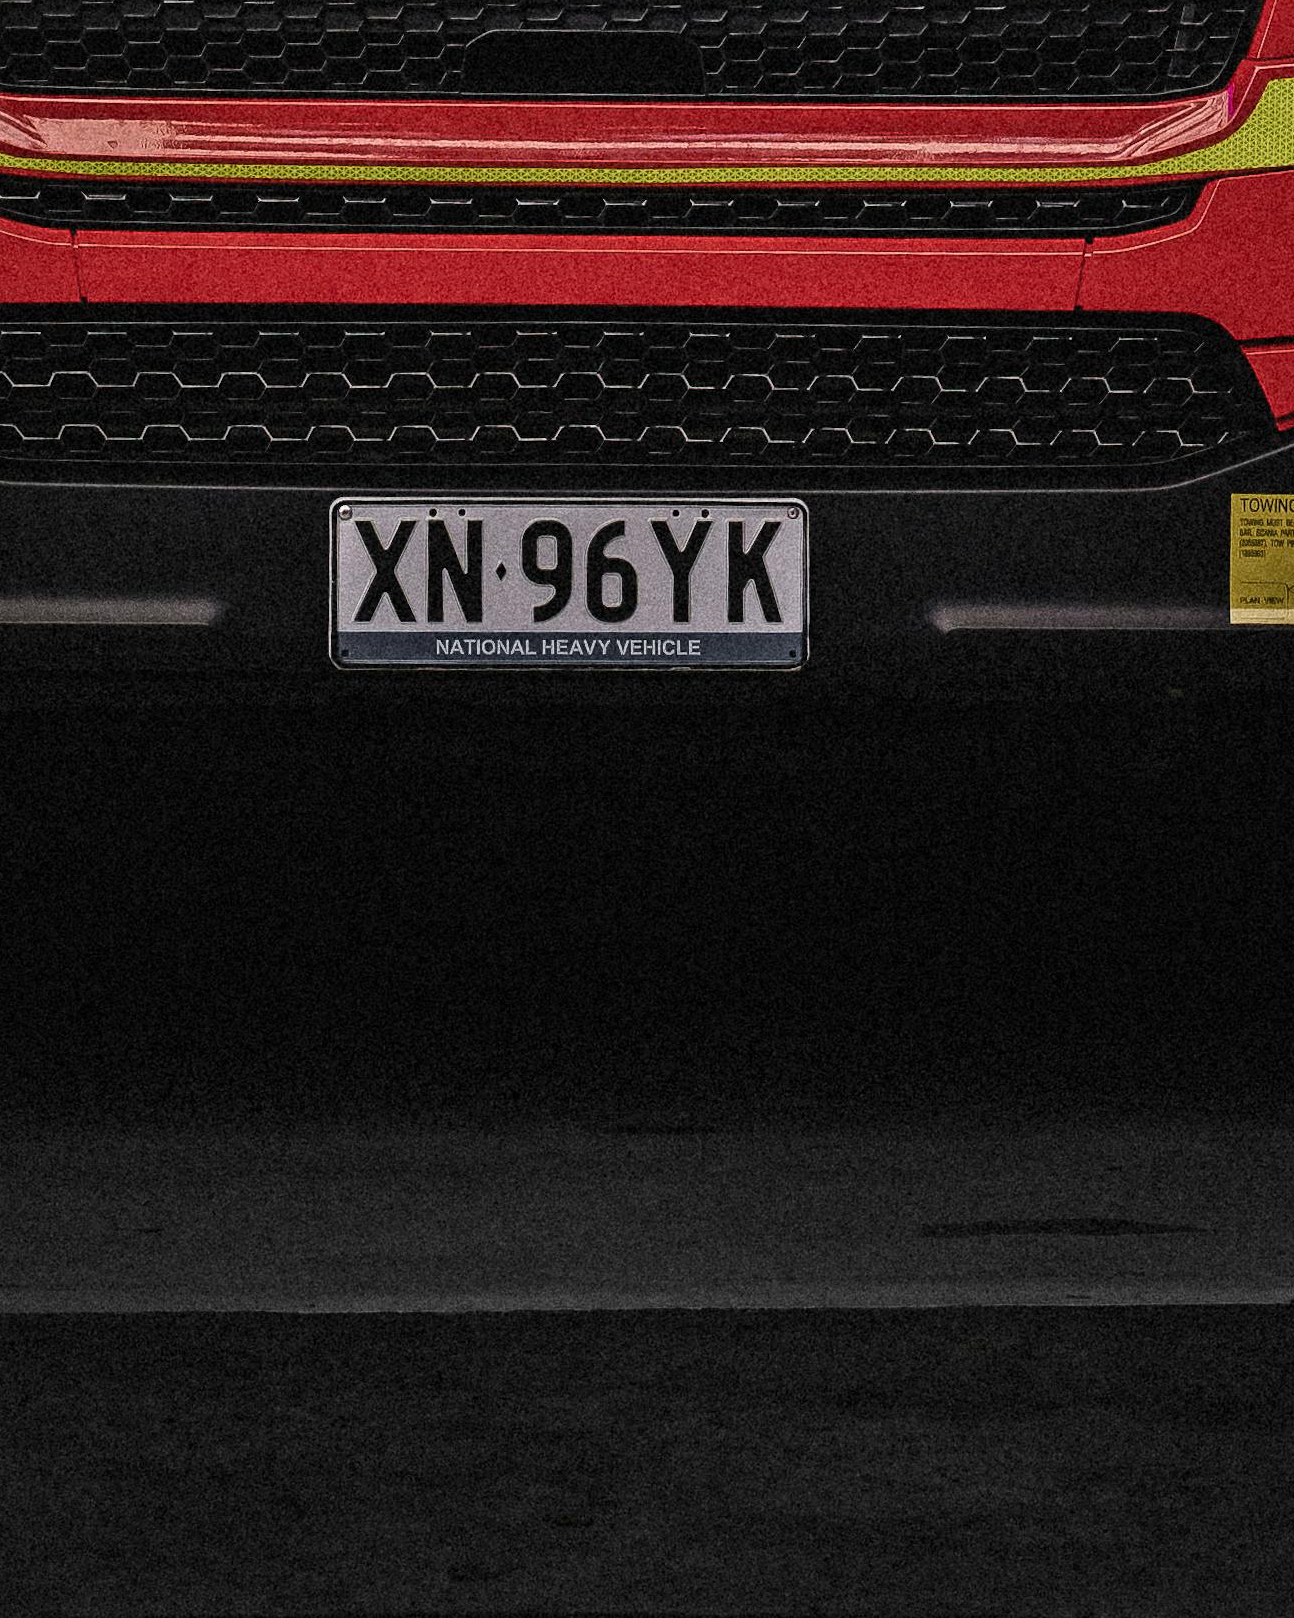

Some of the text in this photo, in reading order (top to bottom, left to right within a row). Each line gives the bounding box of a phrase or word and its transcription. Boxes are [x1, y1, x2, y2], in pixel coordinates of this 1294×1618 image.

[436, 639, 701, 656] NATIONAL HEAVY VEHICLE
